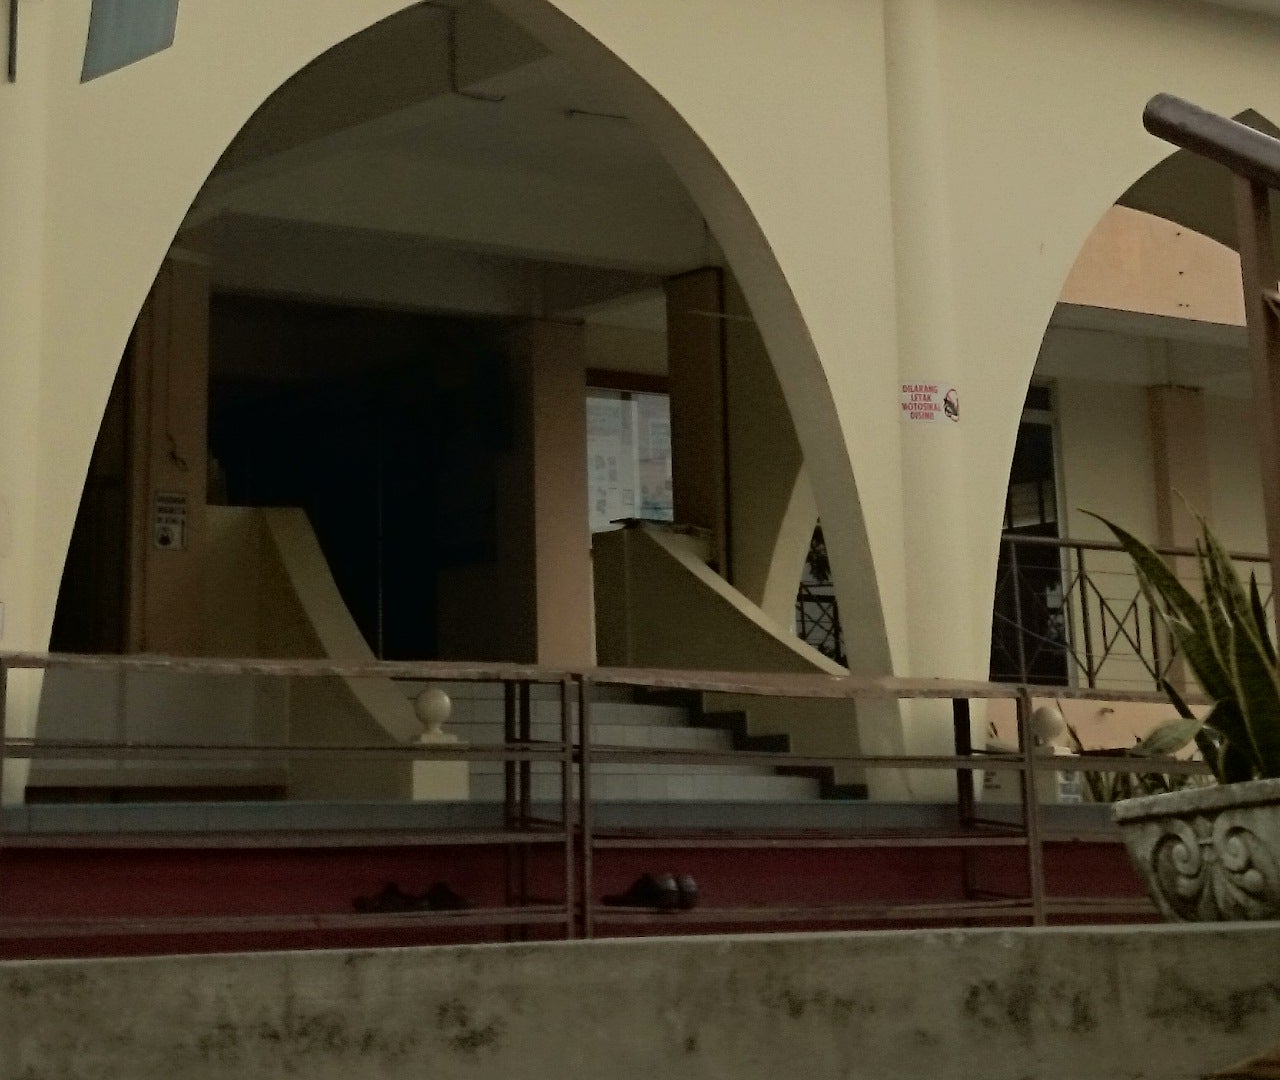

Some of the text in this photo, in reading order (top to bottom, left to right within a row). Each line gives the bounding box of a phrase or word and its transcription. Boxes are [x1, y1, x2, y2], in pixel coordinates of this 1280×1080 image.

[902, 384, 938, 393] DILARANG
[910, 393, 932, 402] LETAK
[901, 402, 941, 412] MOTOSIKAL
